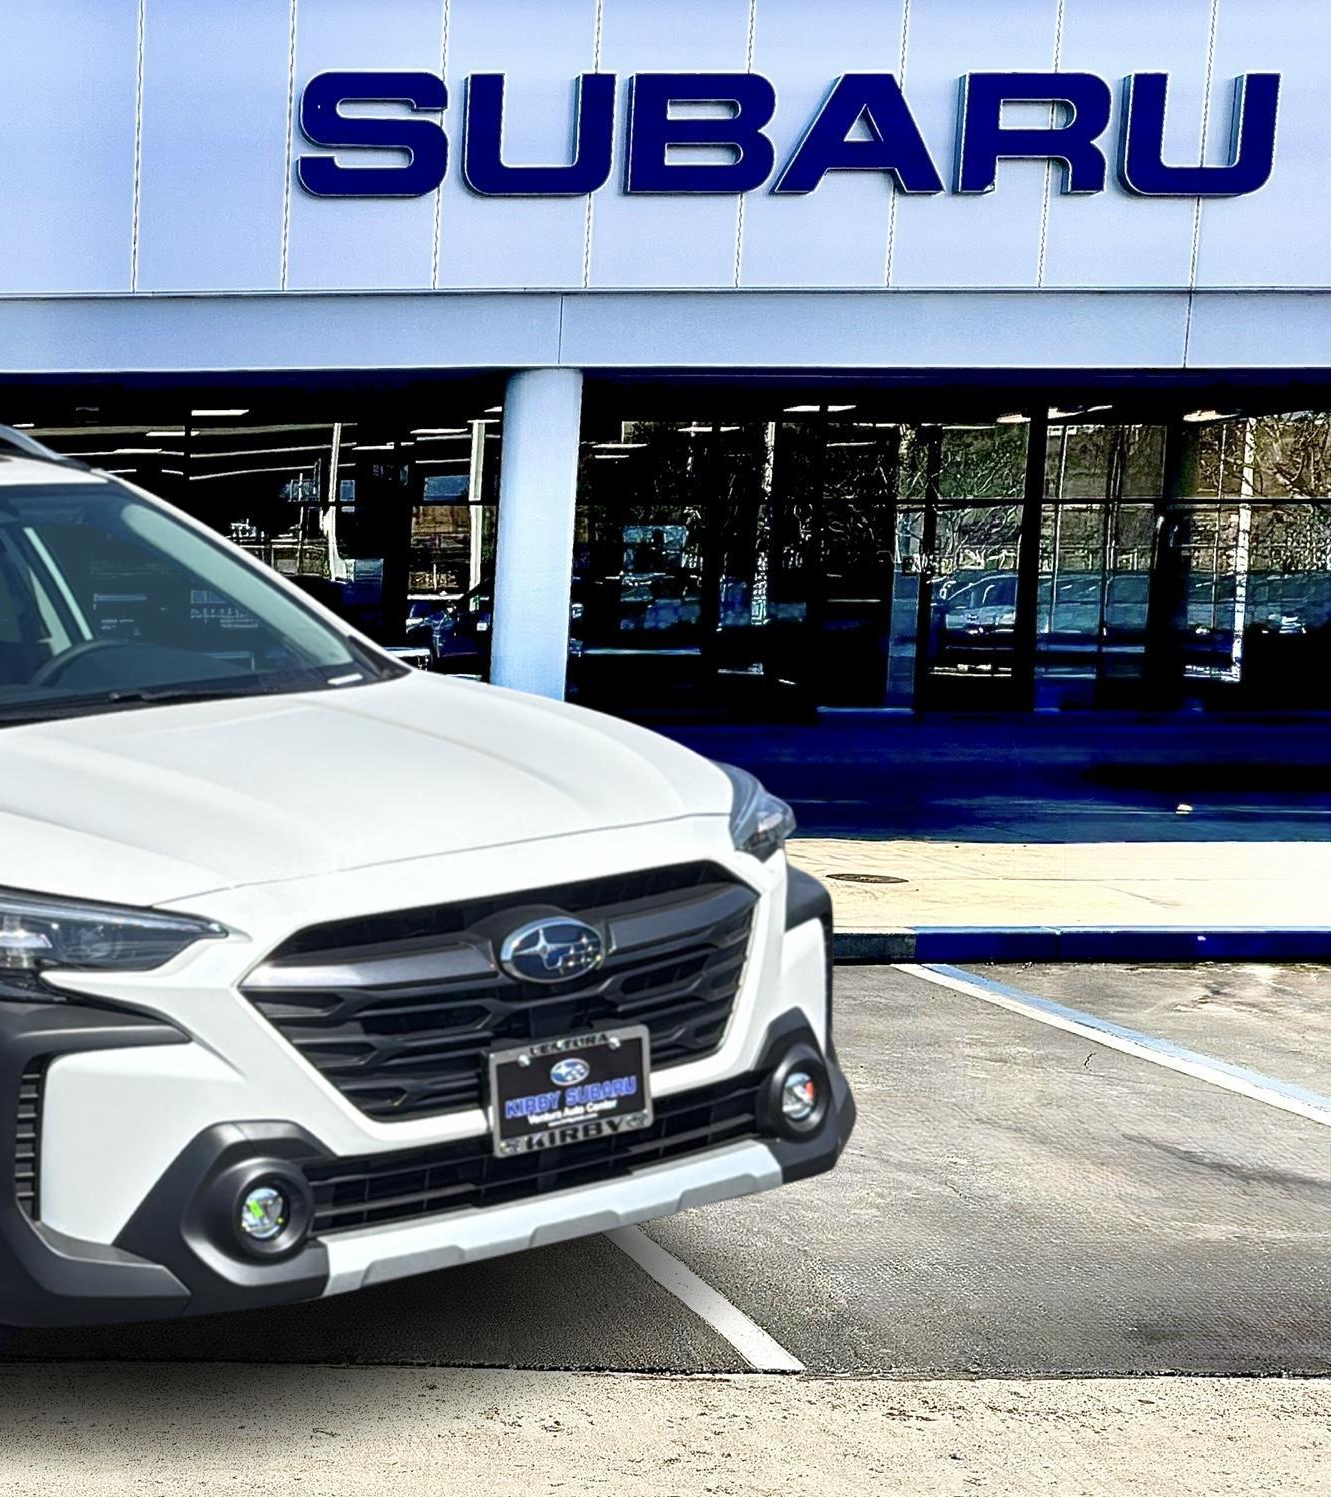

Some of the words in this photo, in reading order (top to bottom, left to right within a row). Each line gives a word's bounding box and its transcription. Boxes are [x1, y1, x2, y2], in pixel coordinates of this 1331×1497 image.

[297, 71, 1280, 197] SUBARU
[505, 1091, 560, 1119] KIRBY
[565, 1076, 636, 1105] SUBARU
[526, 1119, 623, 1149] KIRBY
